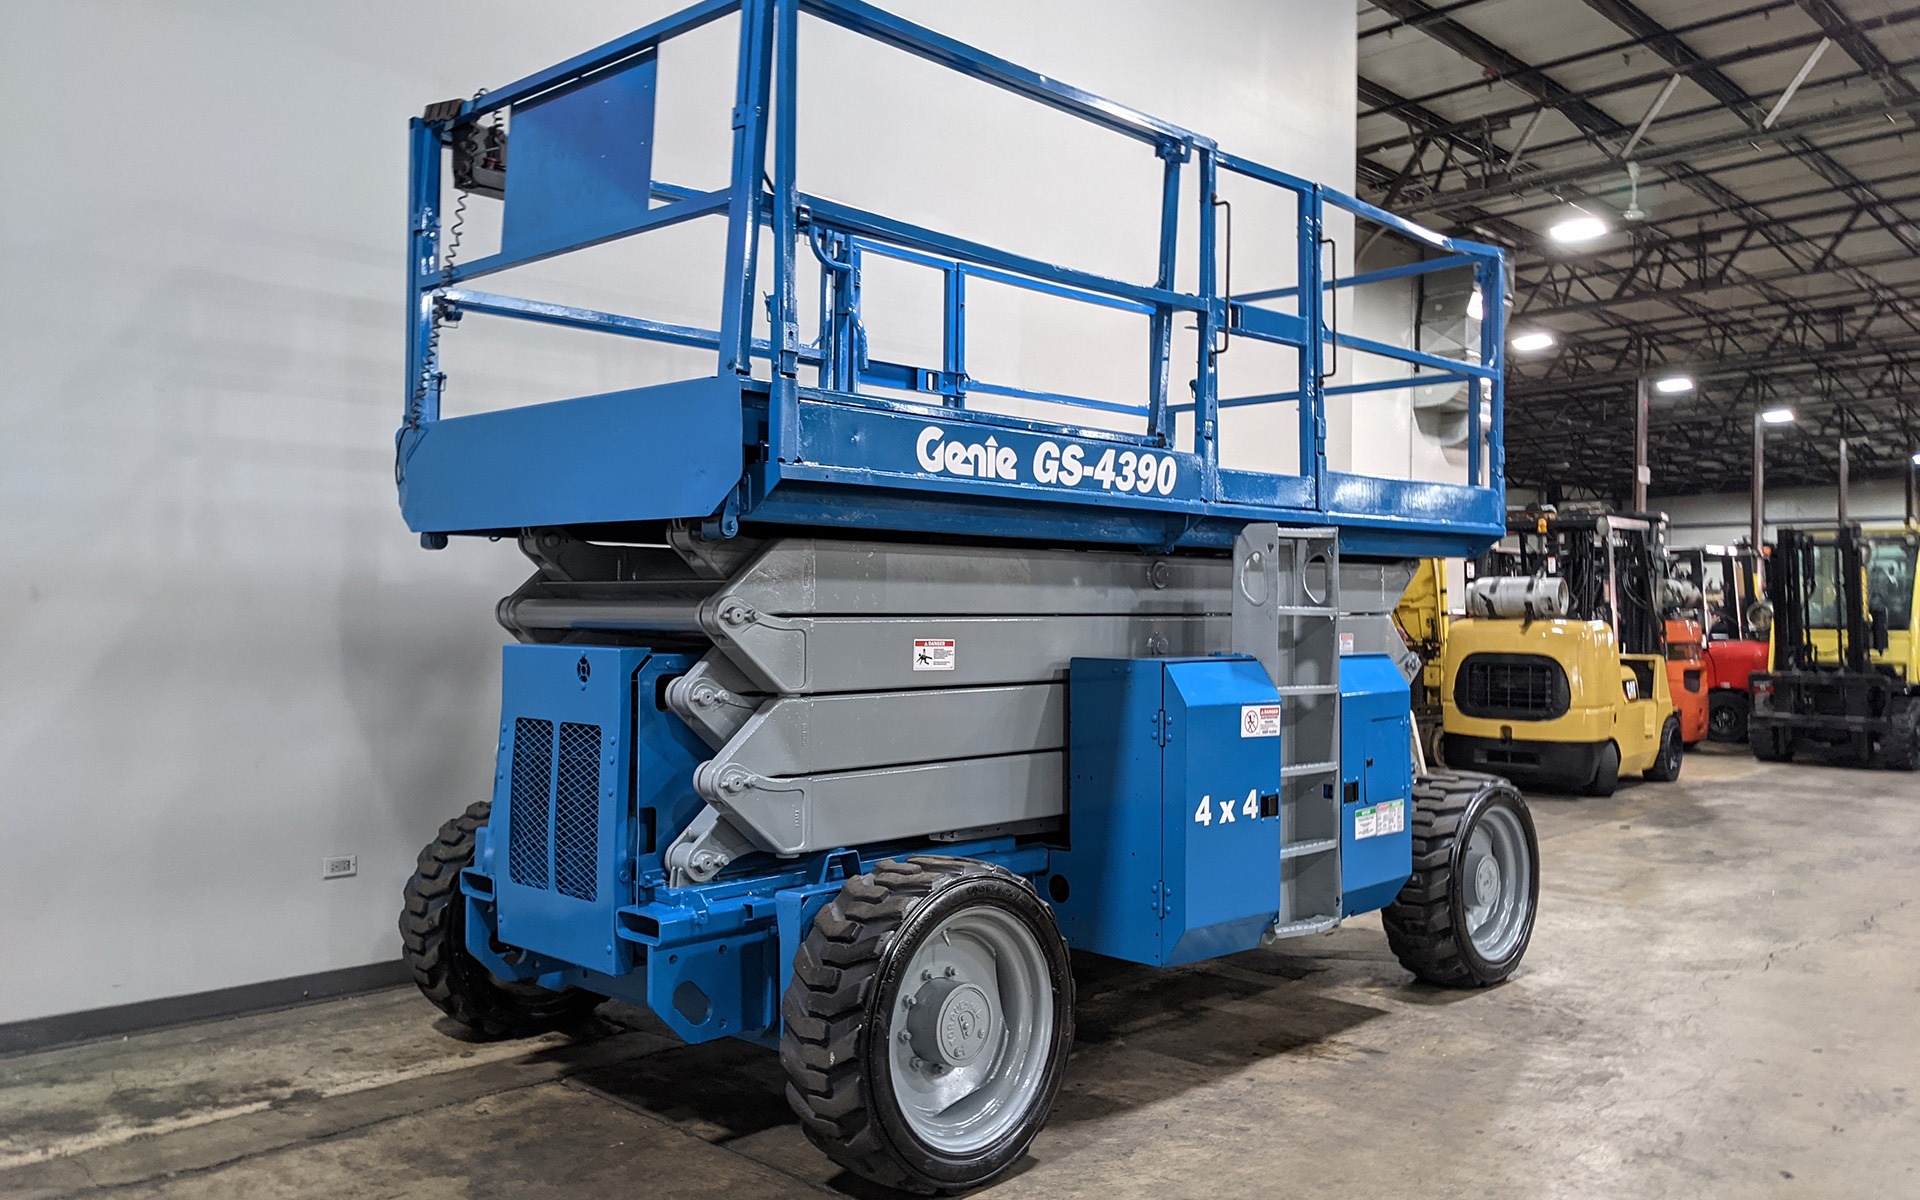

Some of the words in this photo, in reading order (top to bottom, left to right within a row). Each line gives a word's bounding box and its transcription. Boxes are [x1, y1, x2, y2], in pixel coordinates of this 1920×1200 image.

[915, 426, 1018, 481] Genie
[1032, 441, 1178, 496] GS-4390
[1194, 795, 1212, 827] 4
[1219, 799, 1236, 825] x
[1242, 788, 1259, 819] 4
